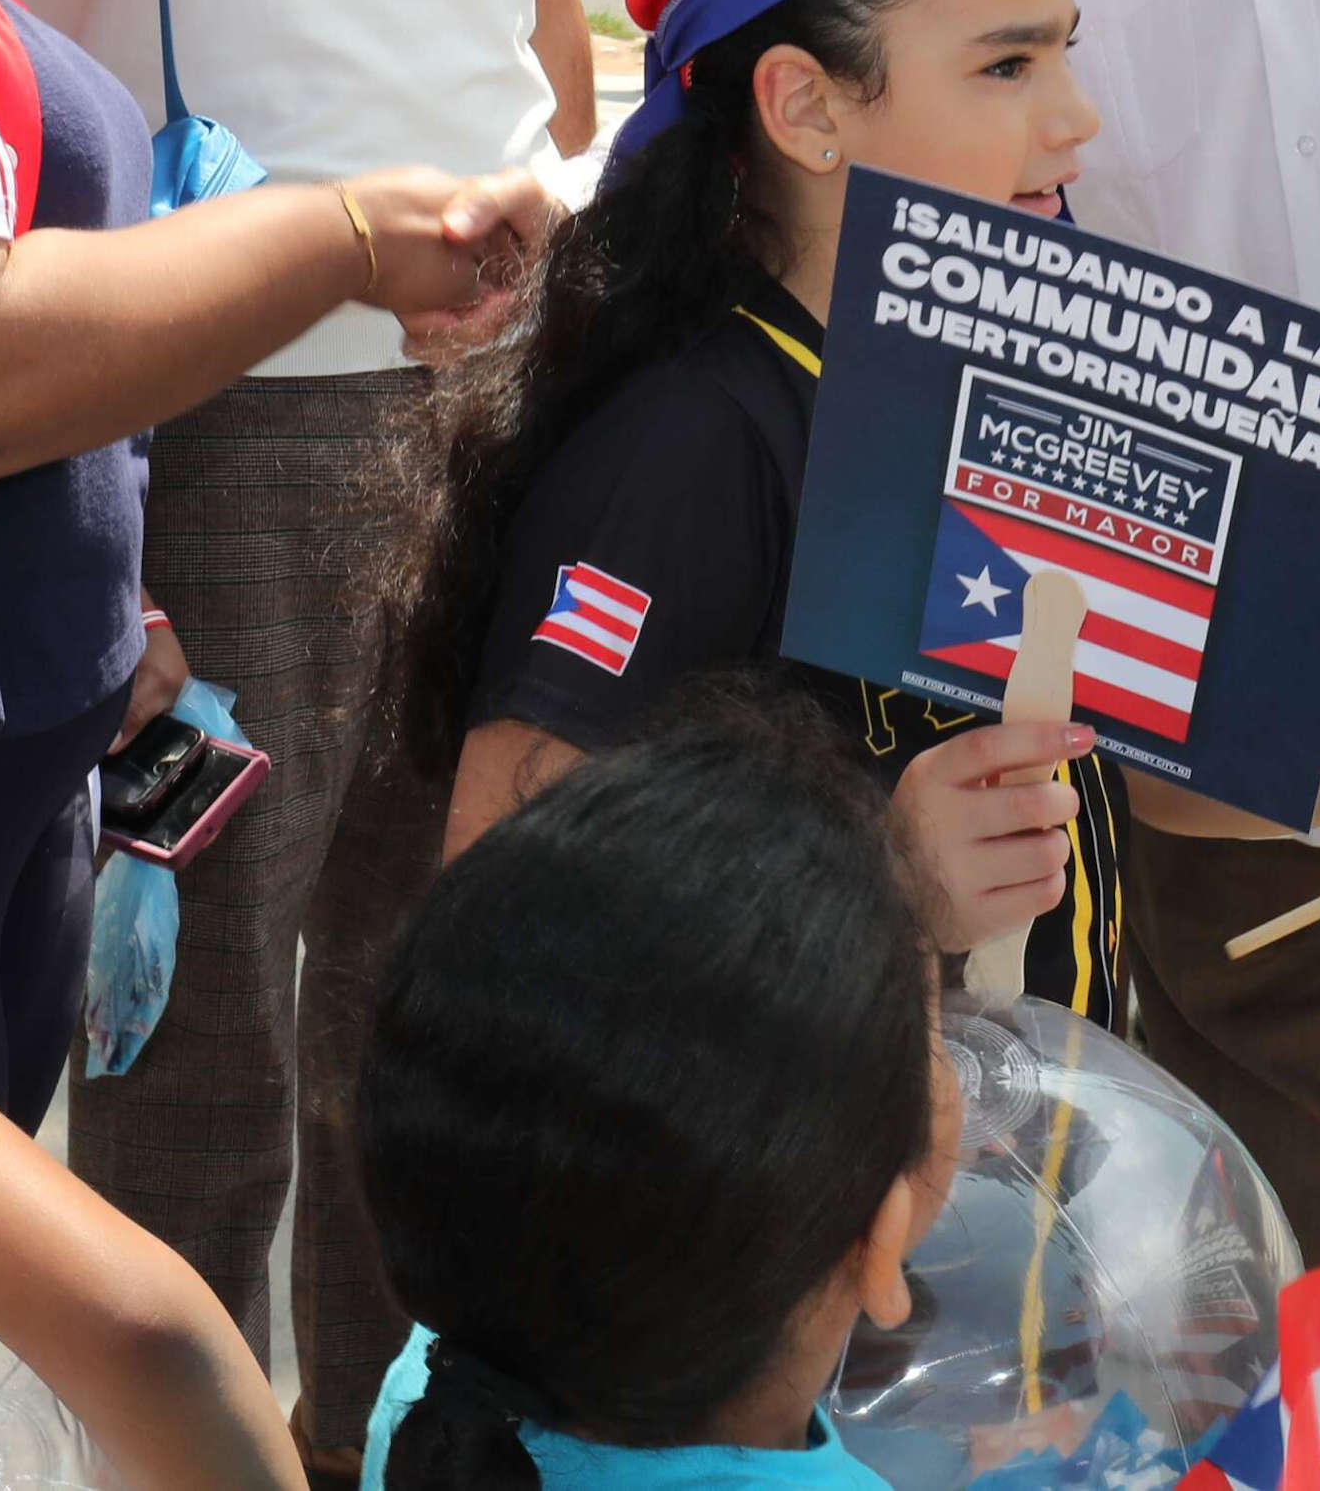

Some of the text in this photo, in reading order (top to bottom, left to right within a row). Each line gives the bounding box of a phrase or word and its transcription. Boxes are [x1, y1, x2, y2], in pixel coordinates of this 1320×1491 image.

[892, 197, 1212, 323] ¡SALUDANDO
[1225, 304, 1266, 346] A
[979, 413, 1209, 510] MCGREEVEY
[1067, 414, 1132, 456] JIM
[966, 472, 1200, 567] FOR MAYOR
